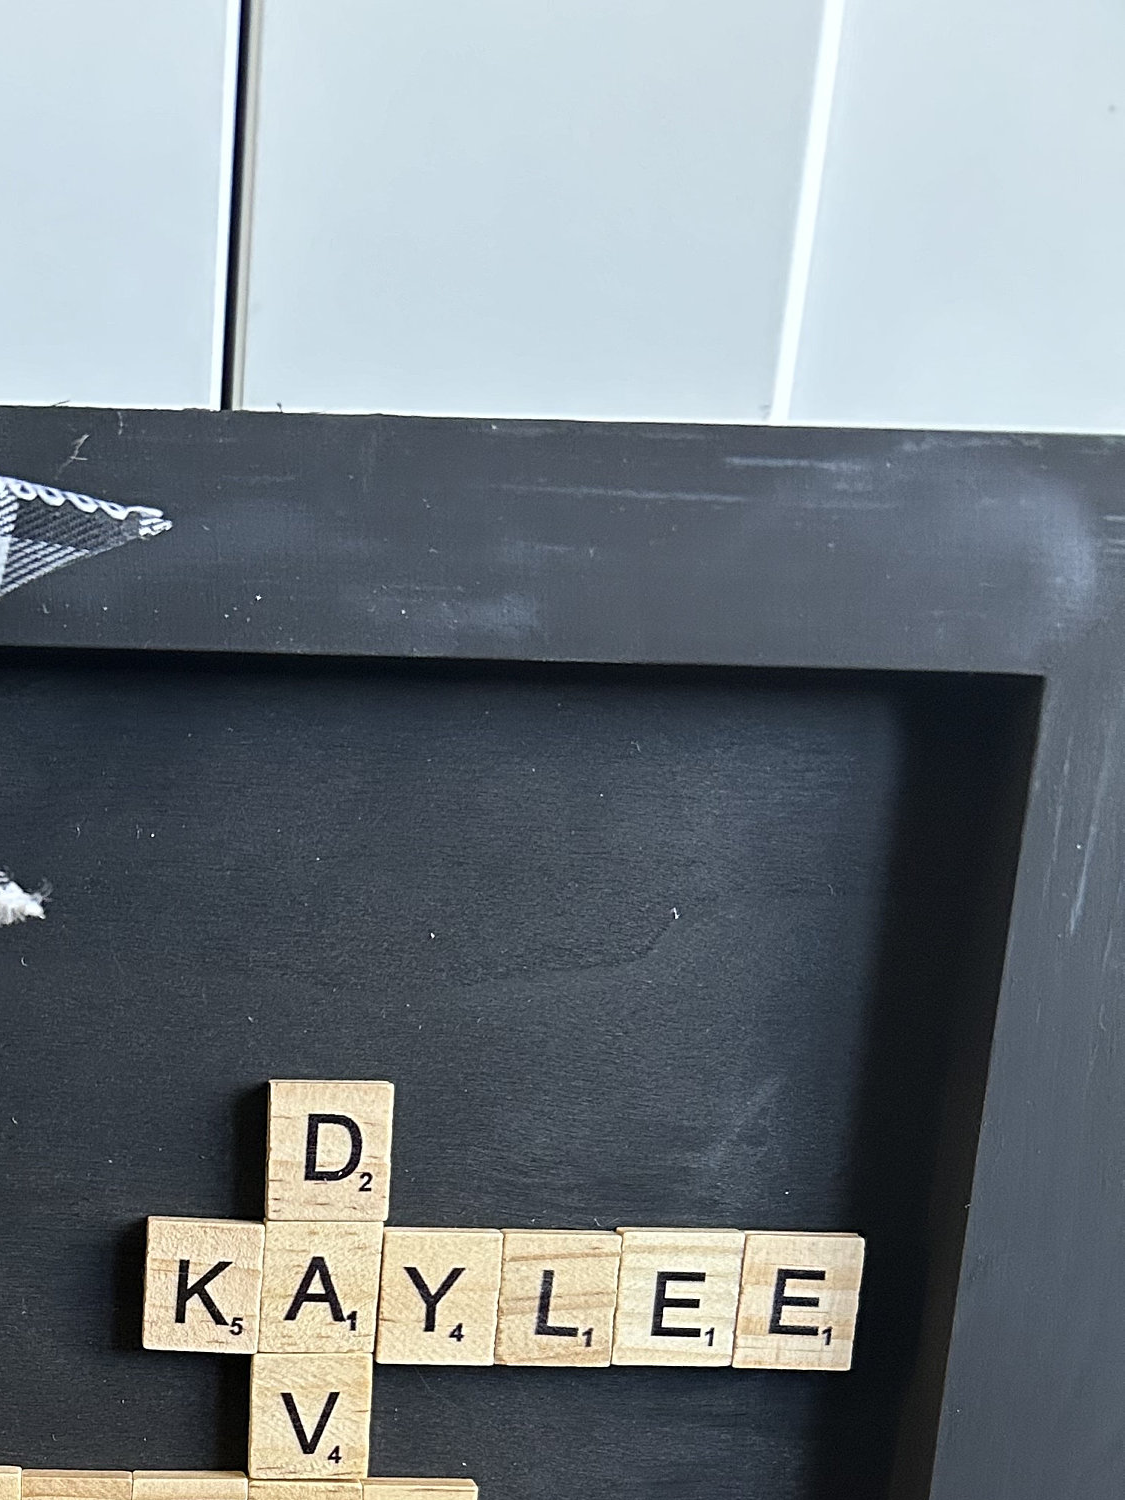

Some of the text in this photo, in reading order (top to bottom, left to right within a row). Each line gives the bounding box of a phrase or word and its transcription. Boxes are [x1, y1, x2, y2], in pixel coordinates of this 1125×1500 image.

[358, 1171, 374, 1192] 2
[173, 1255, 827, 1339] KAYLEE
[229, 1316, 245, 1336] 5
[346, 1310, 359, 1332] 1
[448, 1322, 466, 1342] 4
[582, 1327, 595, 1348] 1
[704, 1327, 716, 1347] 1
[821, 1326, 834, 1346] 1
[327, 1445, 343, 1464] 4
